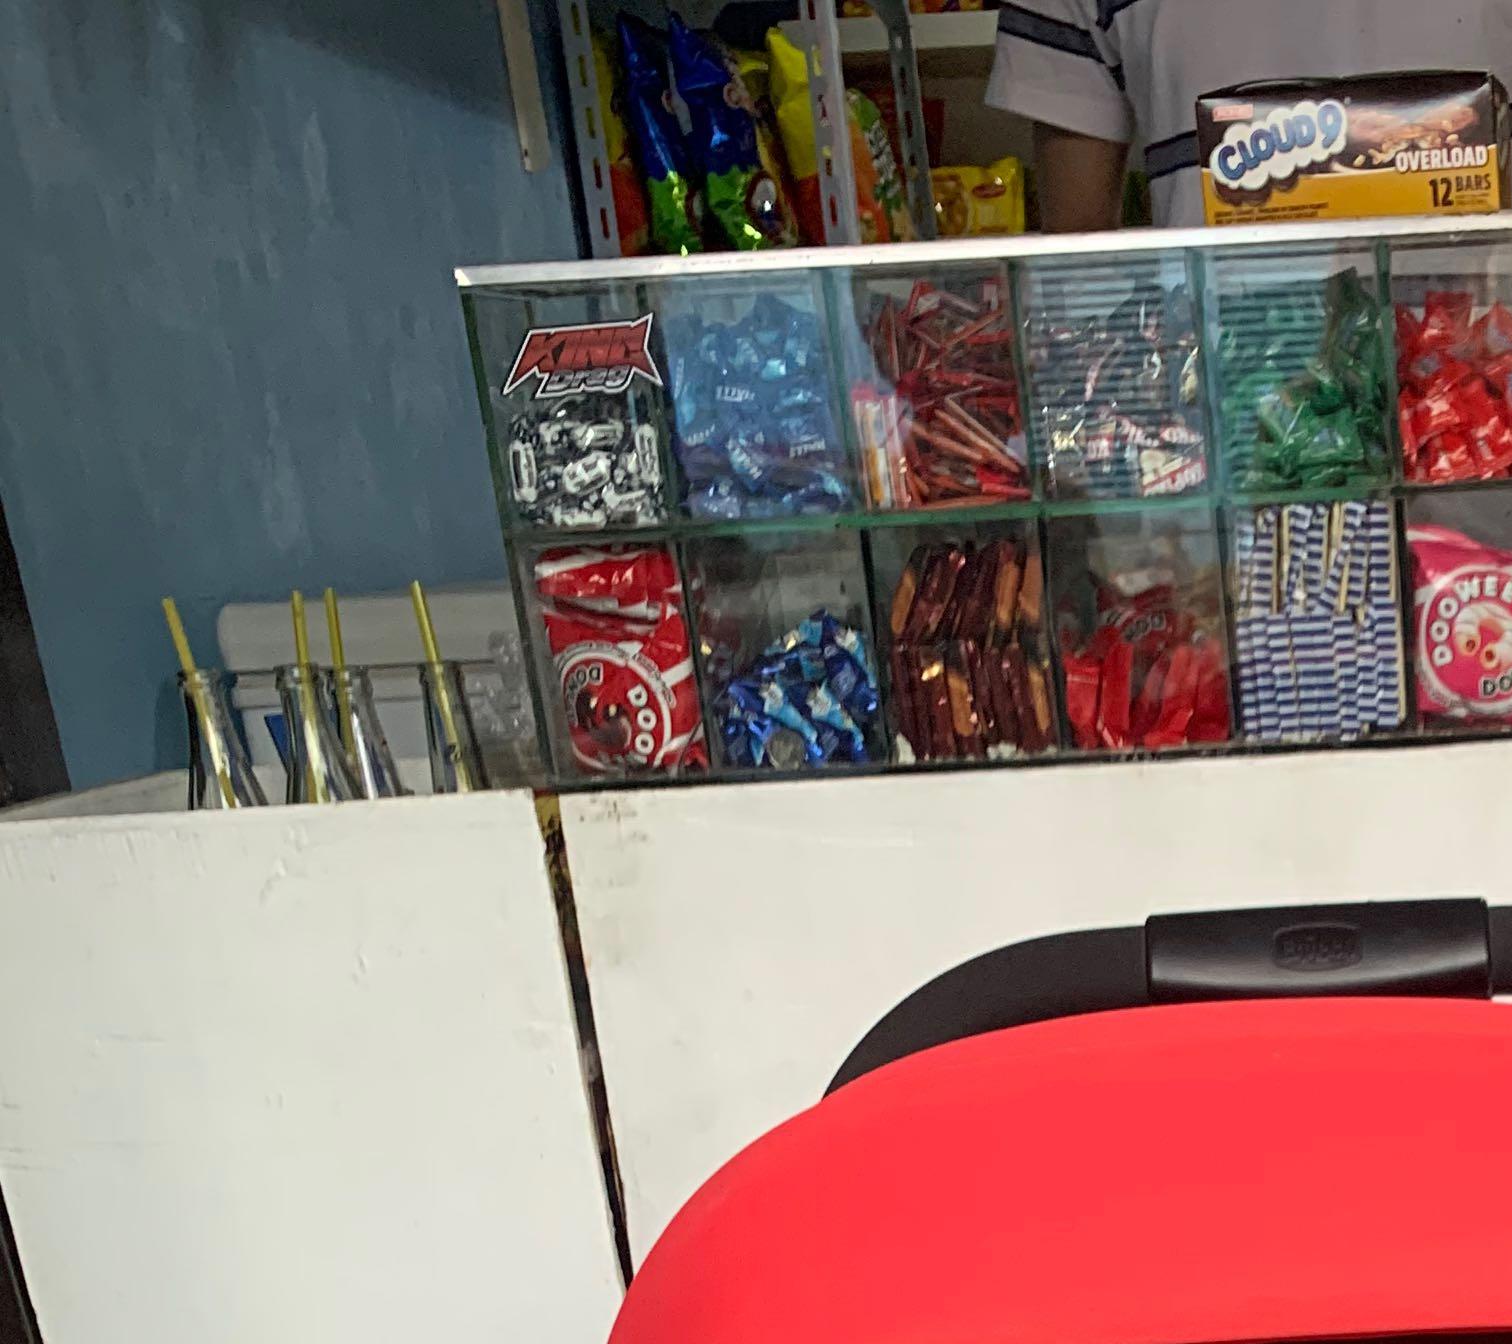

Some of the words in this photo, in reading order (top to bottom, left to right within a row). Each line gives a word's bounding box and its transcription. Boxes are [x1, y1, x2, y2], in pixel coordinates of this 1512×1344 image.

[1217, 113, 1317, 181] CLOUD
[1317, 103, 1343, 150] 9
[1395, 145, 1489, 174] OVERLOAD
[1428, 177, 1455, 208] 12
[1455, 173, 1492, 193] BARS
[508, 317, 658, 386] KING
